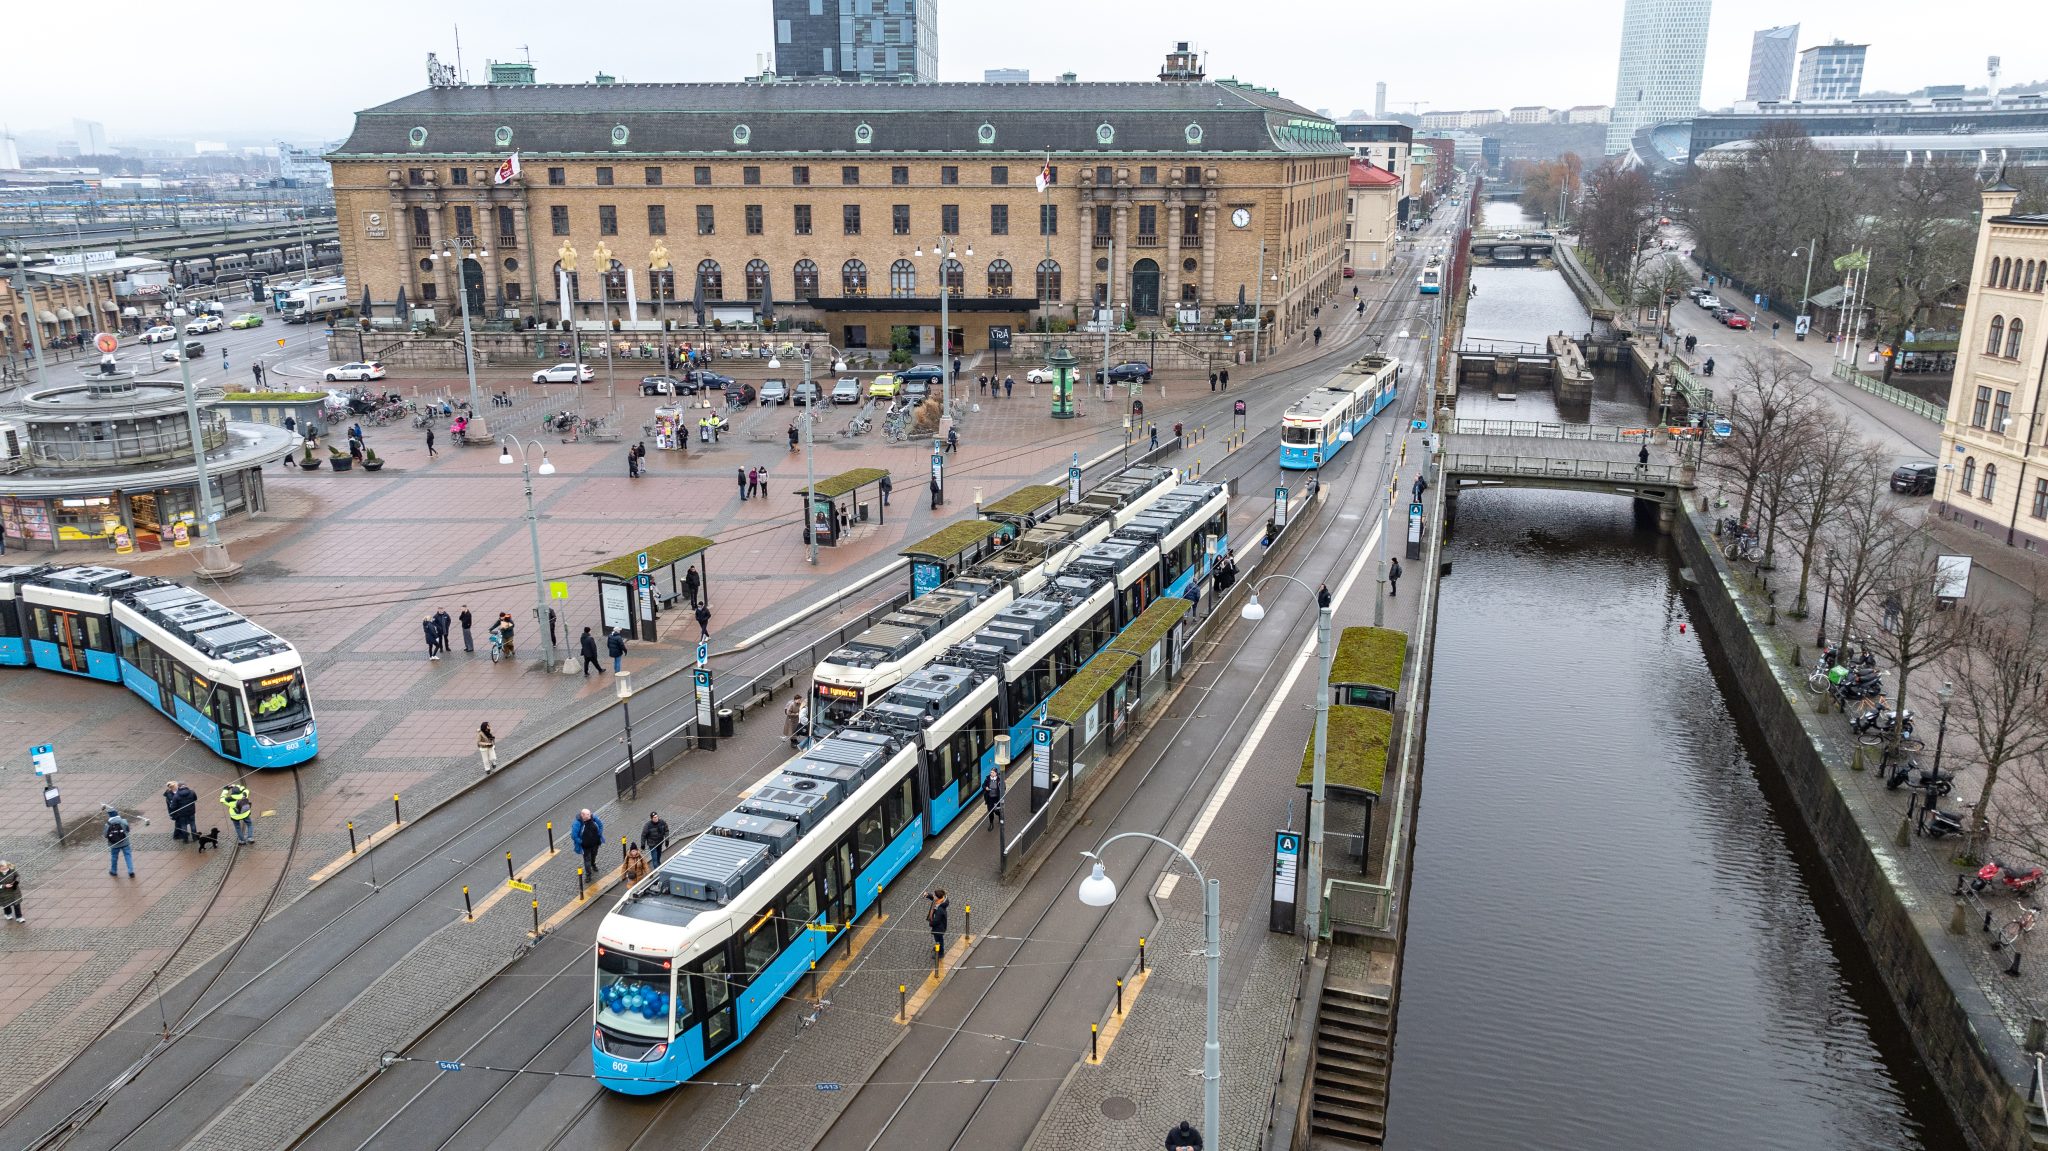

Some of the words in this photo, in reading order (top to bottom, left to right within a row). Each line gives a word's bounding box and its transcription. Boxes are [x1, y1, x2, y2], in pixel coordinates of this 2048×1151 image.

[830, 687, 857, 698] Tynnered
[1038, 732, 1046, 741] B
[286, 742, 299, 751] 603
[1283, 838, 1292, 849] A
[440, 1062, 459, 1071] 5411
[612, 1061, 628, 1073] 602
